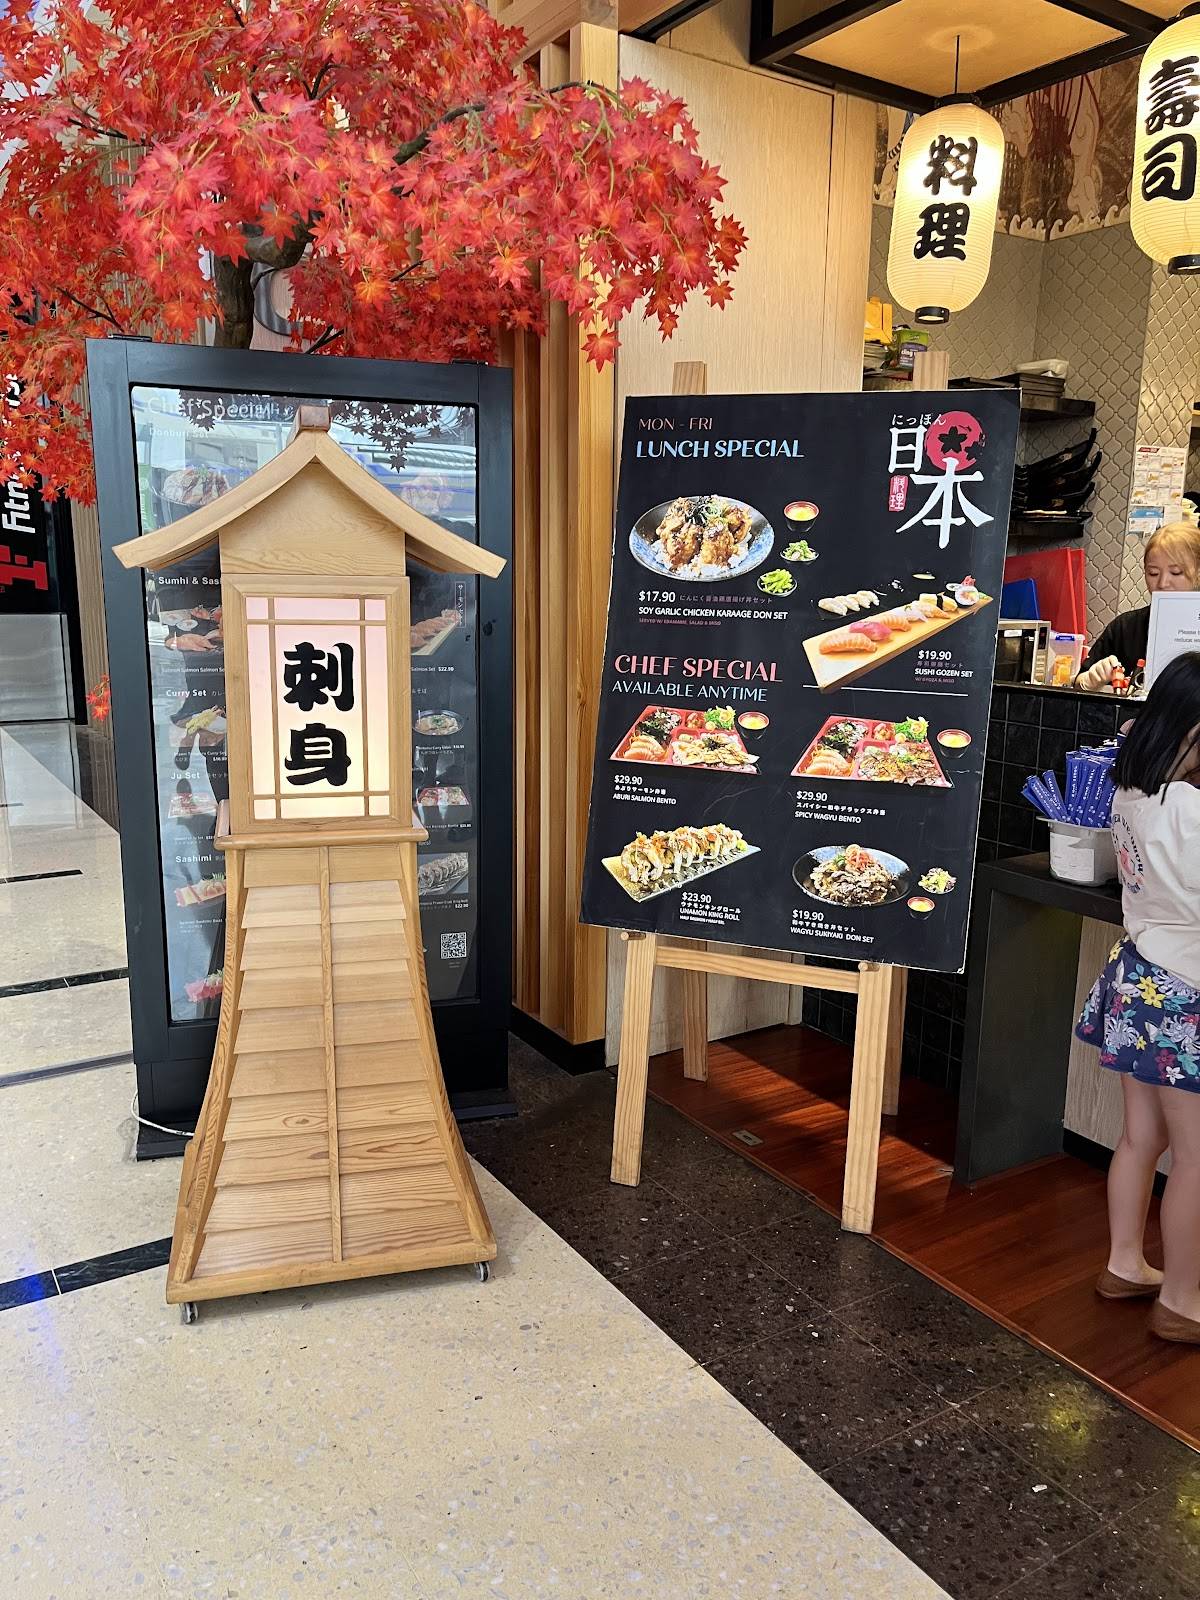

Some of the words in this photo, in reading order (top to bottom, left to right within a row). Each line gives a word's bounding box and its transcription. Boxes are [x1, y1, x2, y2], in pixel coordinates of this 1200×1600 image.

[913, 135, 978, 261] 料理
[638, 418, 674, 430] MON
[689, 417, 713, 430] FRI
[636, 440, 710, 458] LUNCH
[713, 440, 805, 458] SPECIAL
[191, 577, 199, 585] &
[639, 590, 676, 603] $17.90
[638, 606, 654, 616] SOY
[655, 607, 681, 616] GARLIC
[683, 608, 715, 617] CHICKEN
[716, 609, 752, 619] KARAAGE
[753, 610, 772, 619] DON
[773, 611, 788, 620] SET
[918, 650, 952, 661] $19.90
[614, 654, 678, 676] CHEF
[682, 657, 783, 683] SPECIAL
[915, 668, 935, 676] SUSHI
[936, 669, 960, 677] GOZEN
[961, 670, 974, 678] SET
[166, 690, 190, 698] Curry
[612, 680, 694, 698] AVAILABLE
[697, 685, 768, 702] ANYTIME
[283, 641, 354, 788] 刺身
[185, 772, 201, 780] Set
[614, 775, 643, 785] $29.90
[612, 793, 630, 801] ABURI
[631, 795, 656, 803] SALMON
[656, 797, 677, 805] BENTO
[796, 790, 828, 802] $29.90
[813, 812, 838, 821] WAGYU
[838, 815, 862, 823] BENTO
[175, 854, 212, 863] Sashimi
[682, 891, 712, 904] $23.90
[680, 907, 707, 916] UNAMON
[708, 911, 724, 919] KING
[724, 913, 740, 921] ROLL
[792, 909, 824, 922] $19.90
[790, 926, 814, 936] WAGYU
[814, 930, 843, 940] SUKIYAKI
[845, 933, 862, 942] DON
[862, 935, 875, 944] SET
